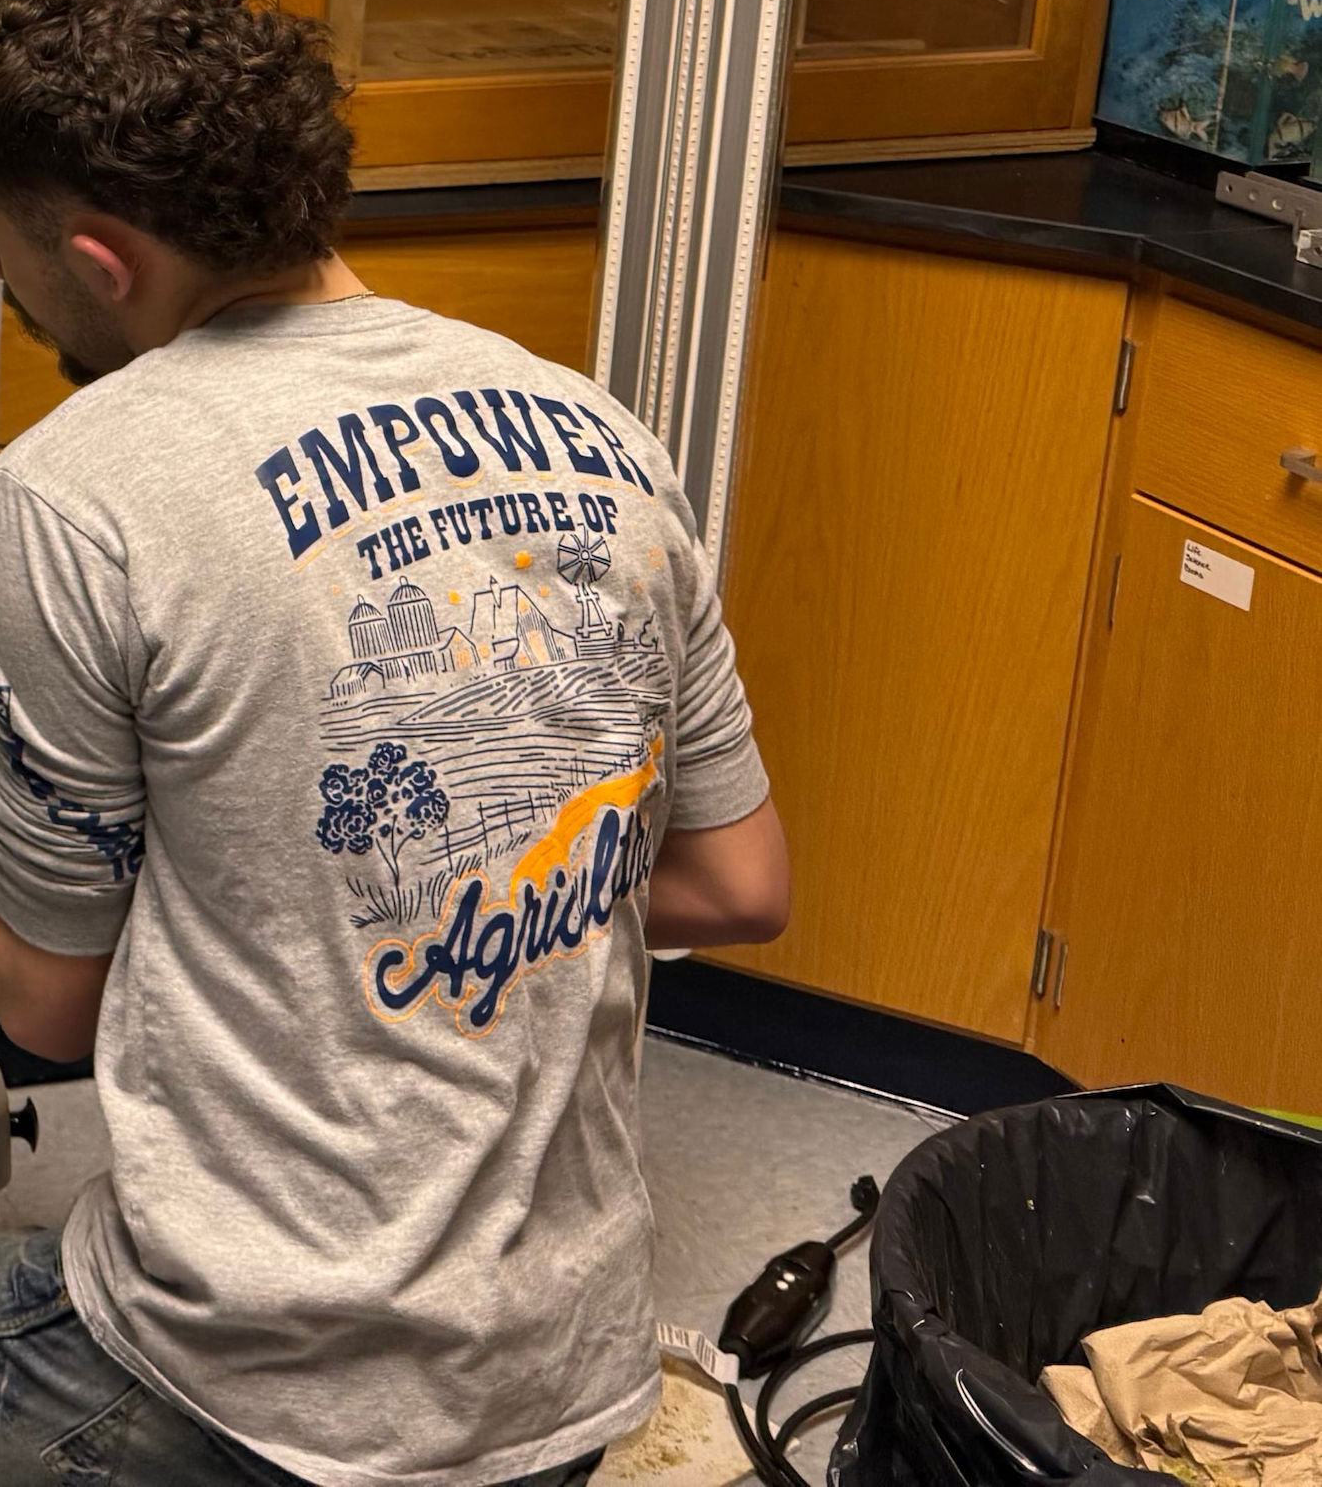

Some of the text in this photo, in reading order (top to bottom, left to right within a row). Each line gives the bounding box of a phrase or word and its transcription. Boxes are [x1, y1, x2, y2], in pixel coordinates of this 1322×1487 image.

[254, 388, 655, 560] EMPOWER
[356, 492, 619, 580] THE FUTURE OF
